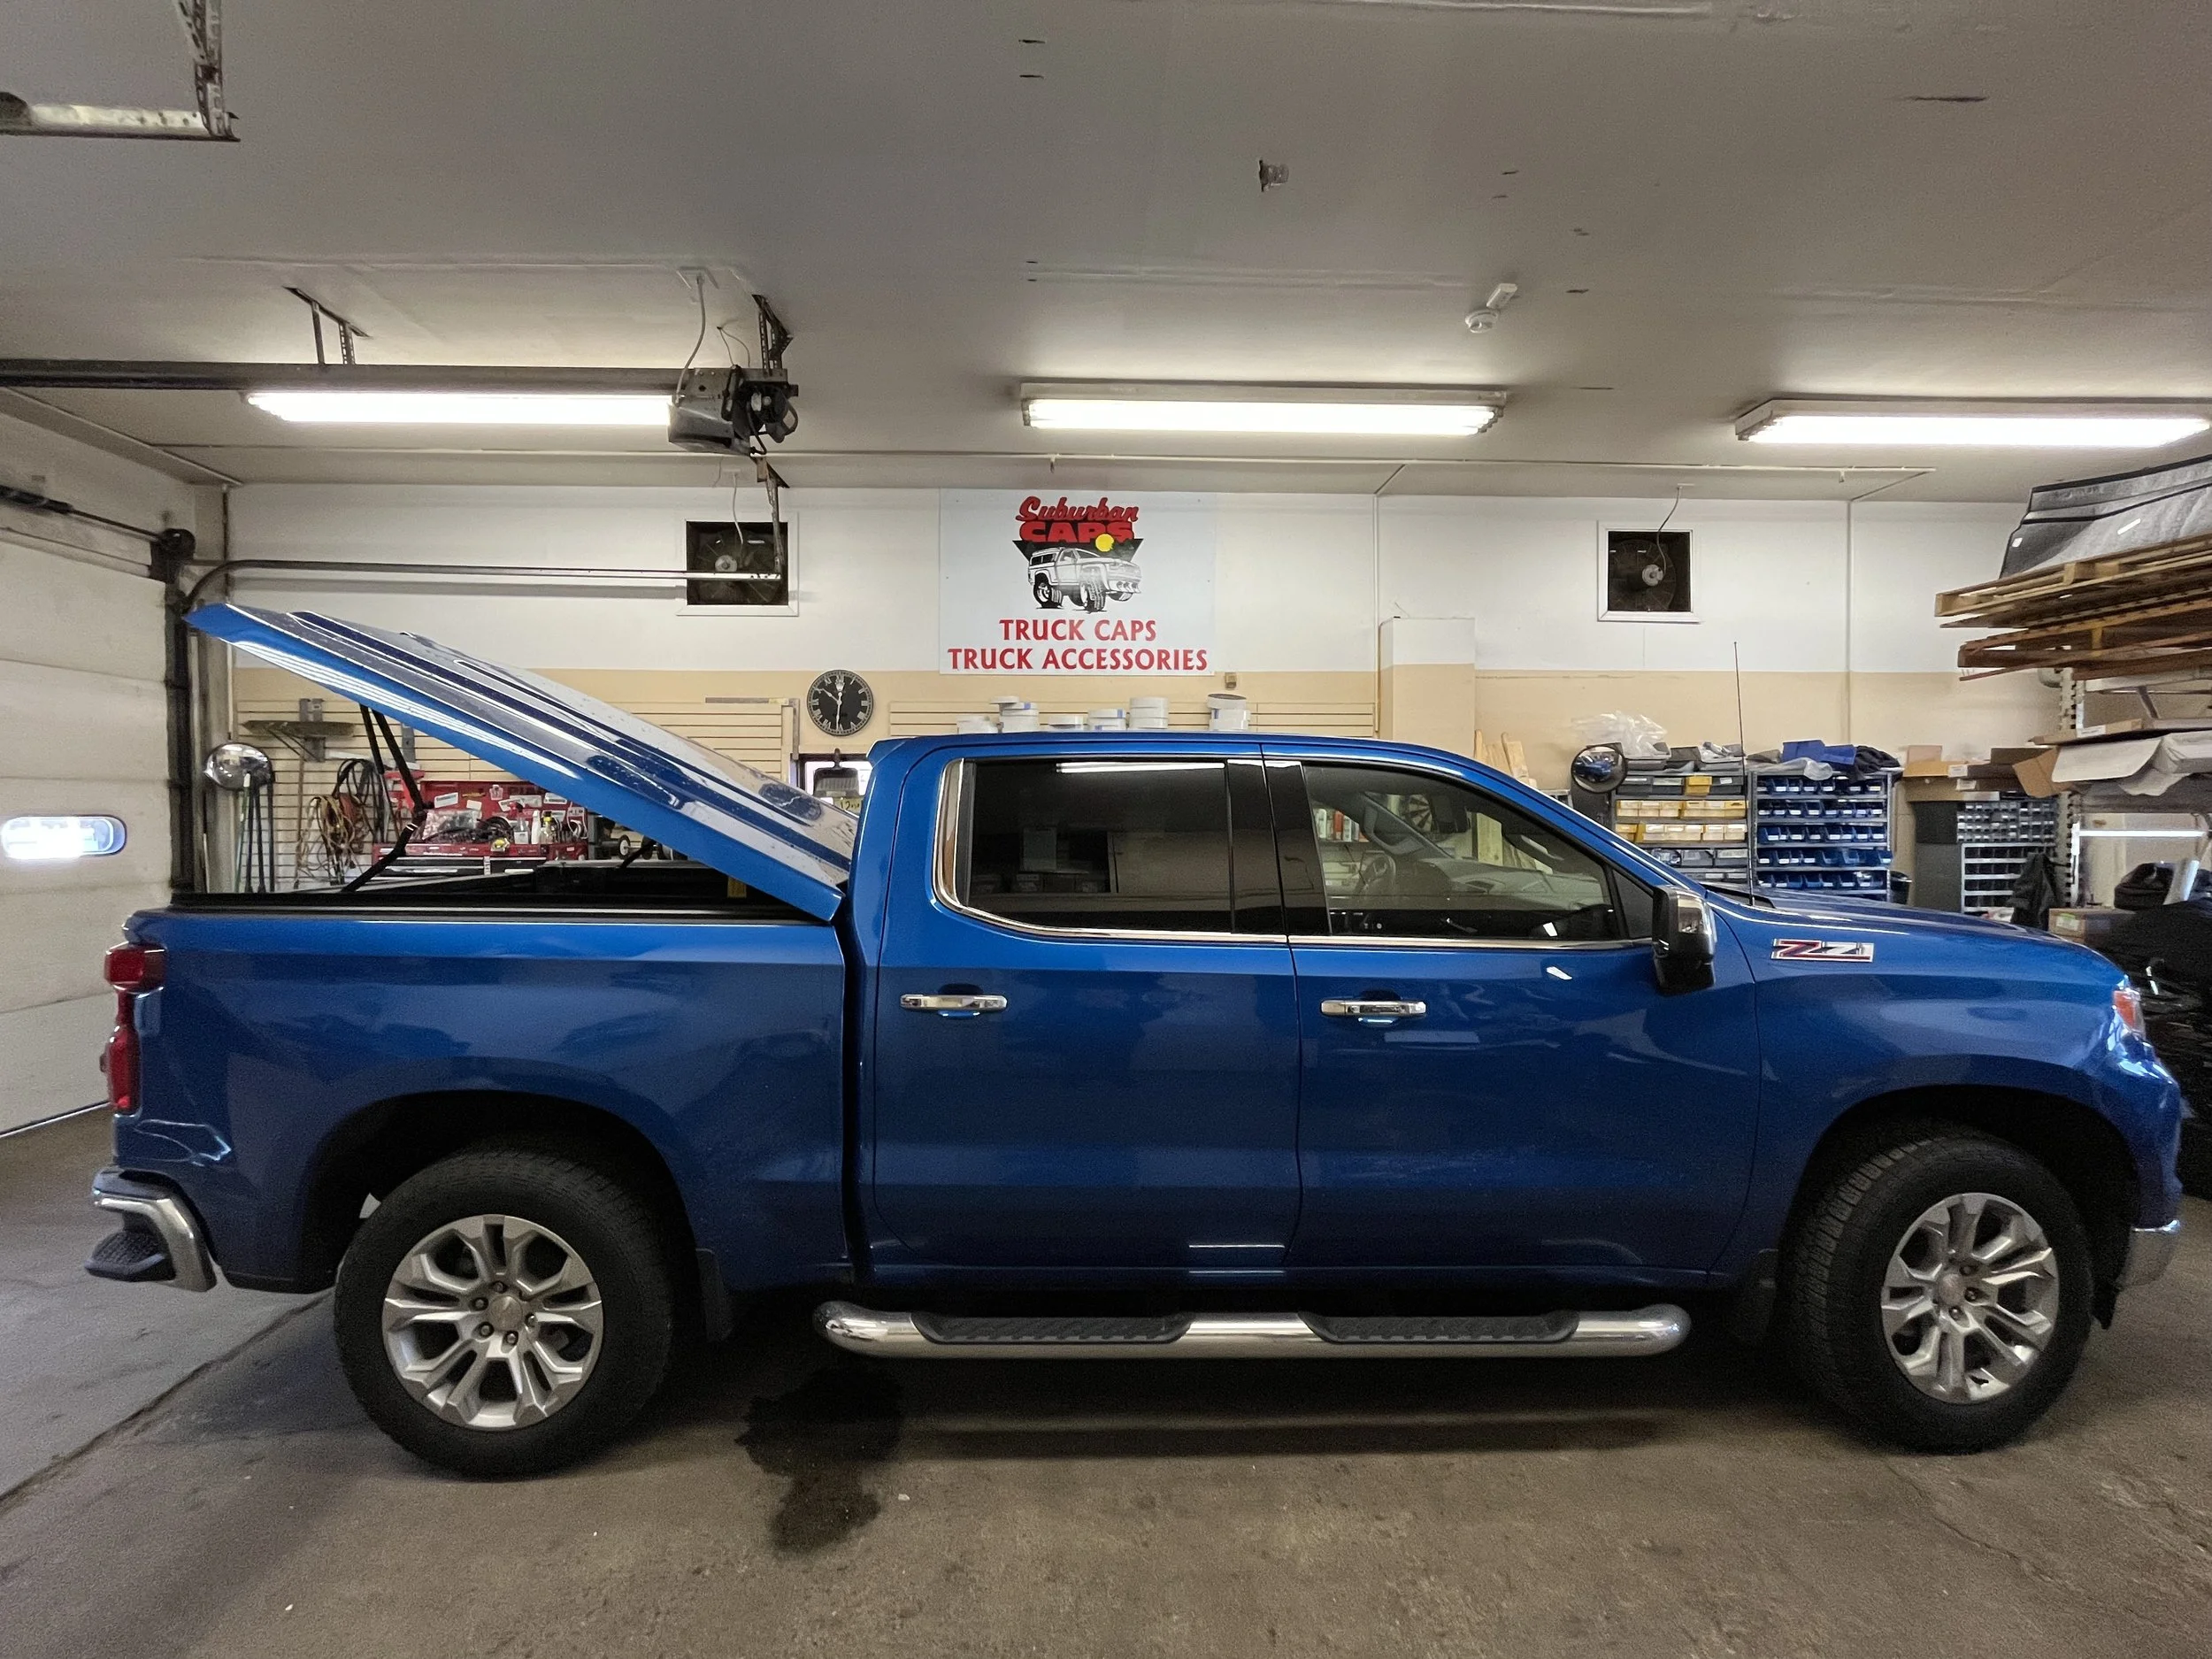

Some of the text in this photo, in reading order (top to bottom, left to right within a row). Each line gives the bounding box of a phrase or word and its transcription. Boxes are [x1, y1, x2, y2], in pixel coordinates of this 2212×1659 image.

[1016, 495, 1140, 522] Suburban
[1019, 520, 1134, 543] CAPS
[999, 619, 1156, 641] TRUCK CAPS
[948, 649, 1208, 672] TRUCK ACCESSORIES
